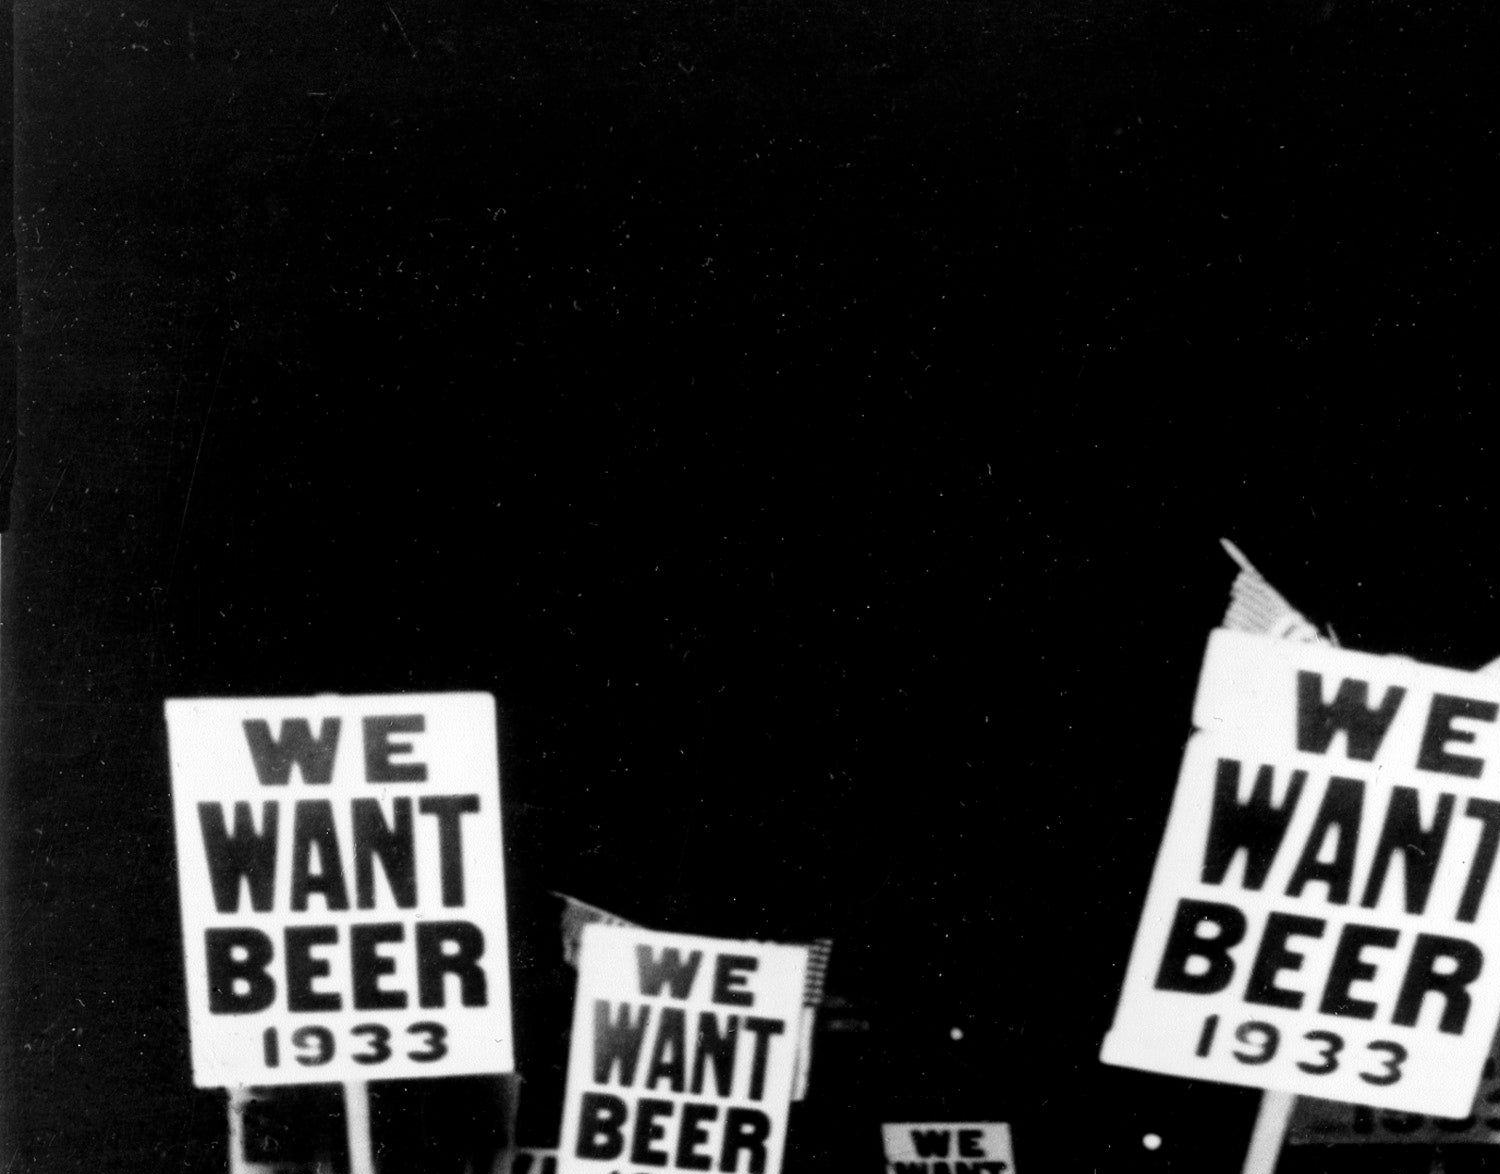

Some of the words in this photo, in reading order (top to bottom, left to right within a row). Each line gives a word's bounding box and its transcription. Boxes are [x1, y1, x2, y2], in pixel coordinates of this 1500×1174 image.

[242, 714, 428, 785] WE
[1297, 669, 1500, 779] WE
[196, 794, 480, 914] WANT
[205, 921, 488, 1015] BEER
[636, 944, 758, 1007] WE
[1153, 898, 1484, 1035] BEER
[263, 1021, 449, 1068] 1933
[594, 999, 784, 1100] WANT
[1195, 1014, 1408, 1086] 1933
[910, 1129, 986, 1158] WE
